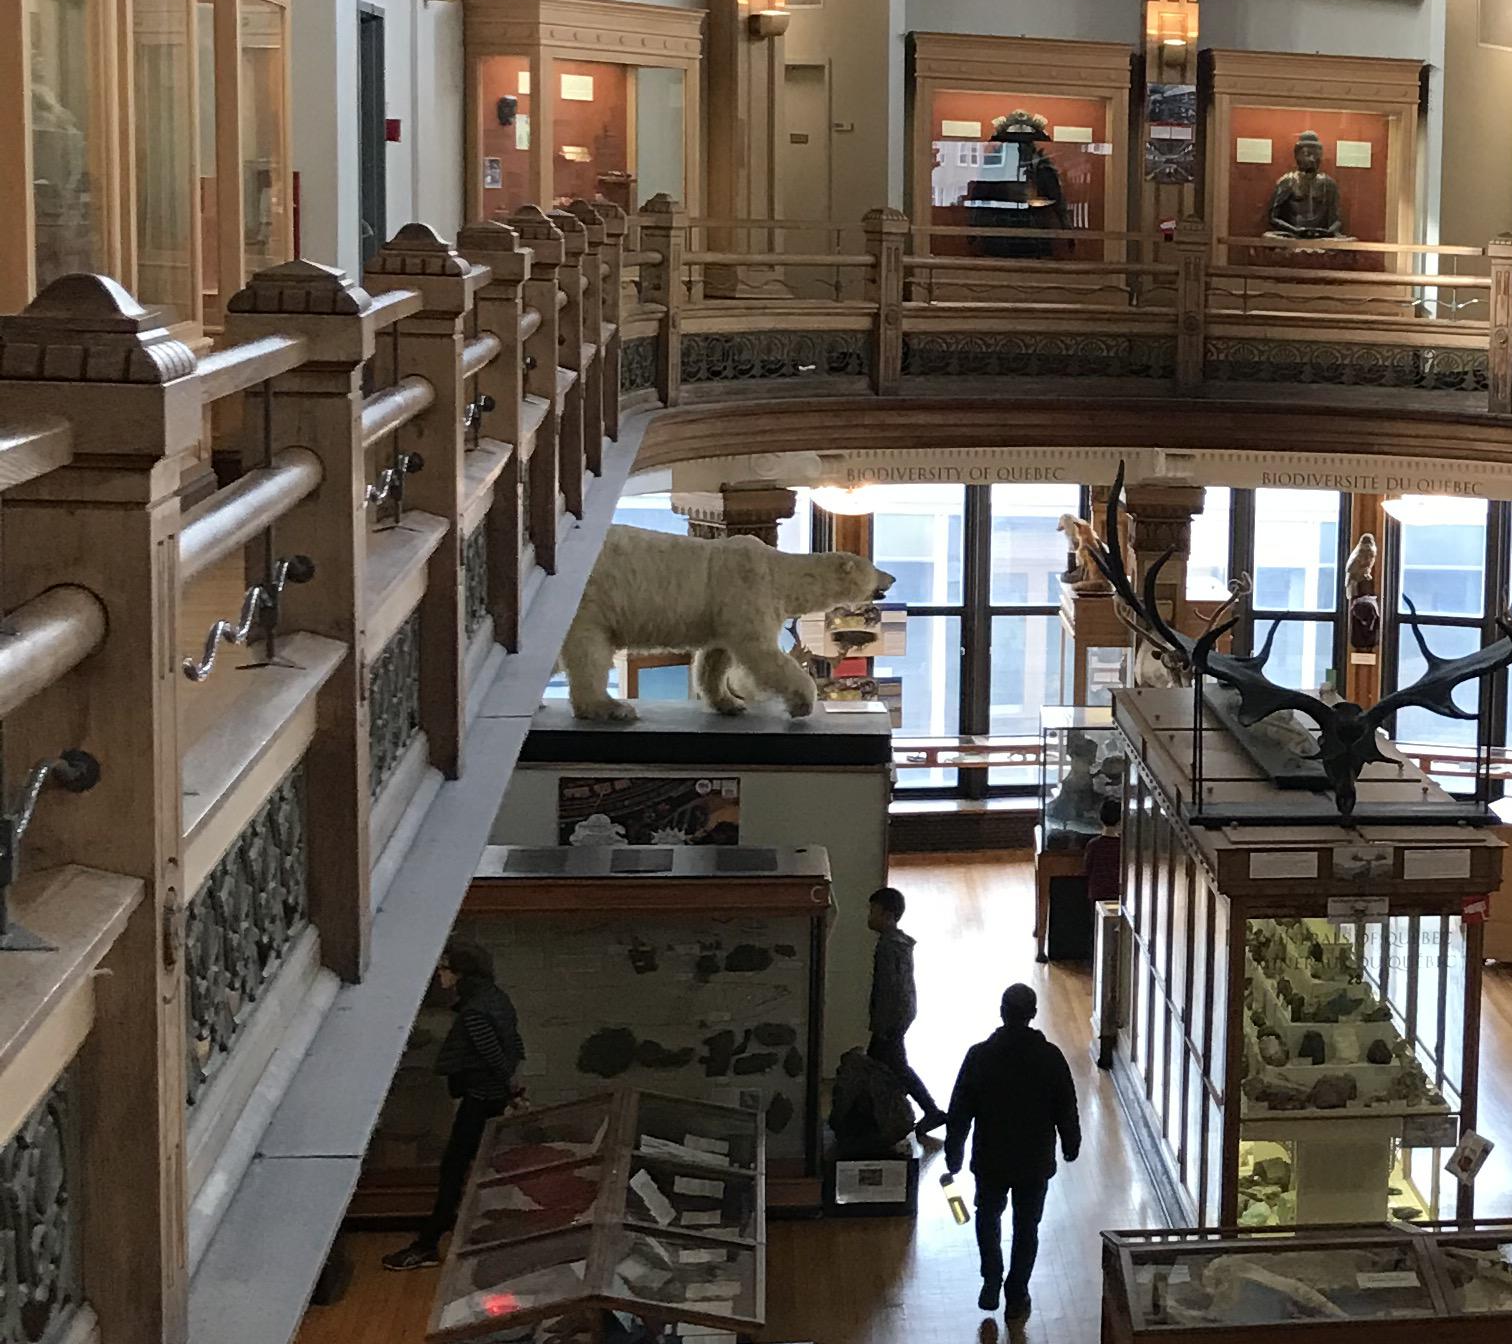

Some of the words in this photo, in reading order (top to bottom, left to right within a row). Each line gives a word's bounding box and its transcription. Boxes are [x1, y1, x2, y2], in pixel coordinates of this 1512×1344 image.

[846, 467, 961, 482] BIODIVERSITY
[969, 467, 991, 481] OF
[996, 467, 1066, 482] QUEBEC
[1386, 476, 1411, 491] DU
[810, 885, 826, 904] C
[1386, 931, 1454, 948] QUBEC
